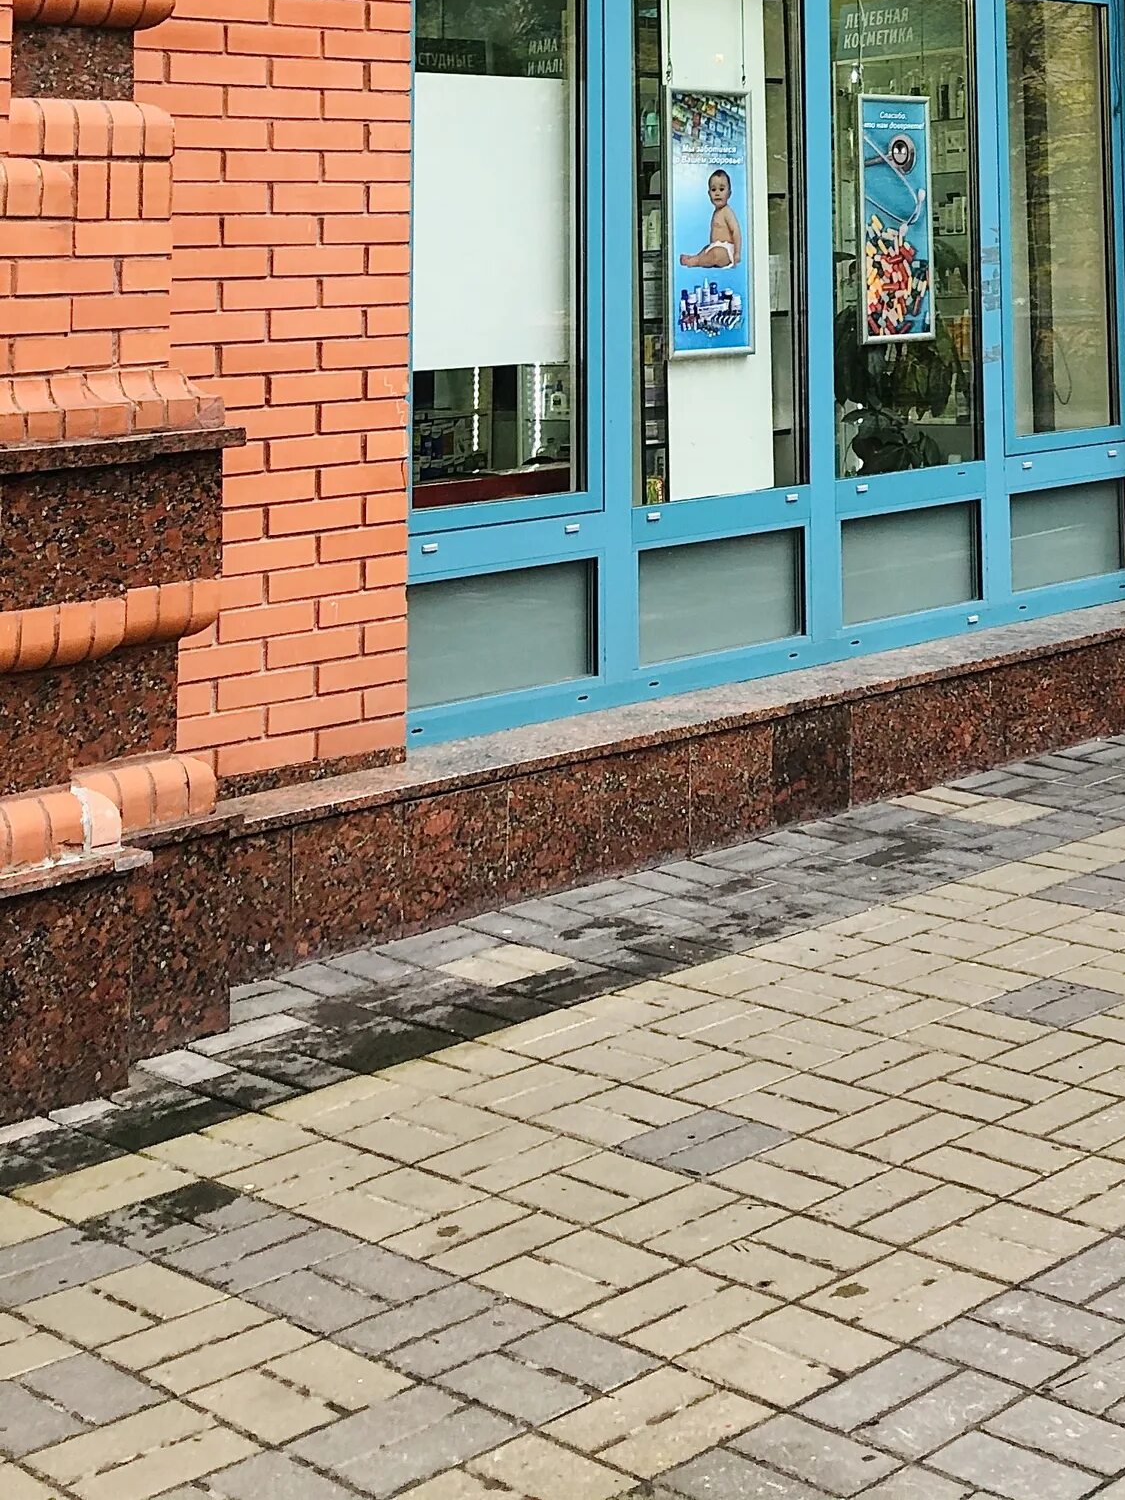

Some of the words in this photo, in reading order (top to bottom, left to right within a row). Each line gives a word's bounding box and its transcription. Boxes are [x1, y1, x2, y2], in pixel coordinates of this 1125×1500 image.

[844, 6, 910, 30] ЛЕЧЕБНАЯ
[843, 26, 914, 50] КОСМЕТИКА
[416, 51, 474, 69] СТУДНЫЕ
